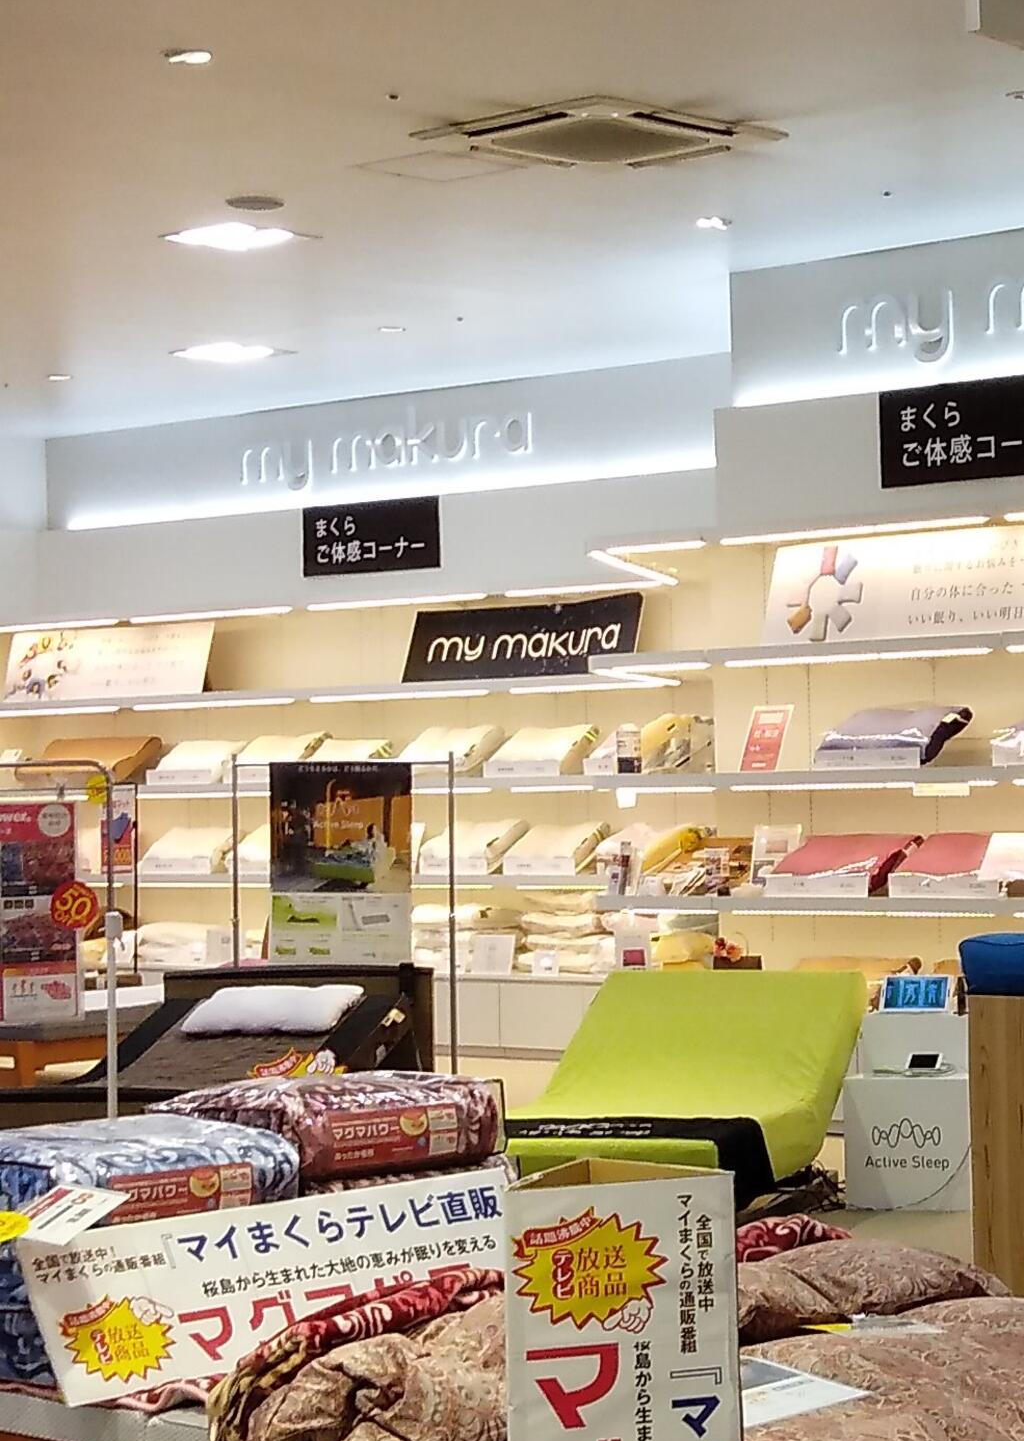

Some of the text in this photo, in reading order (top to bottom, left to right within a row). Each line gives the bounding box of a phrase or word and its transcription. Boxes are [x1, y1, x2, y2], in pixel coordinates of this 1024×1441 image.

[838, 287, 955, 363] my
[899, 401, 961, 433] まくら
[240, 407, 533, 491] my makura
[315, 515, 356, 538] まくら
[316, 537, 426, 565] ご体感コーナー
[427, 622, 622, 663] my makura
[864, 1155, 951, 1172] Active Sleep
[120, 1182, 189, 1203] グマパワー
[576, 1244, 628, 1273] 放送
[695, 1214, 715, 1313] 全国で放送中
[577, 1272, 628, 1300] 商品
[676, 1194, 698, 1355] マイまくらの通販番組
